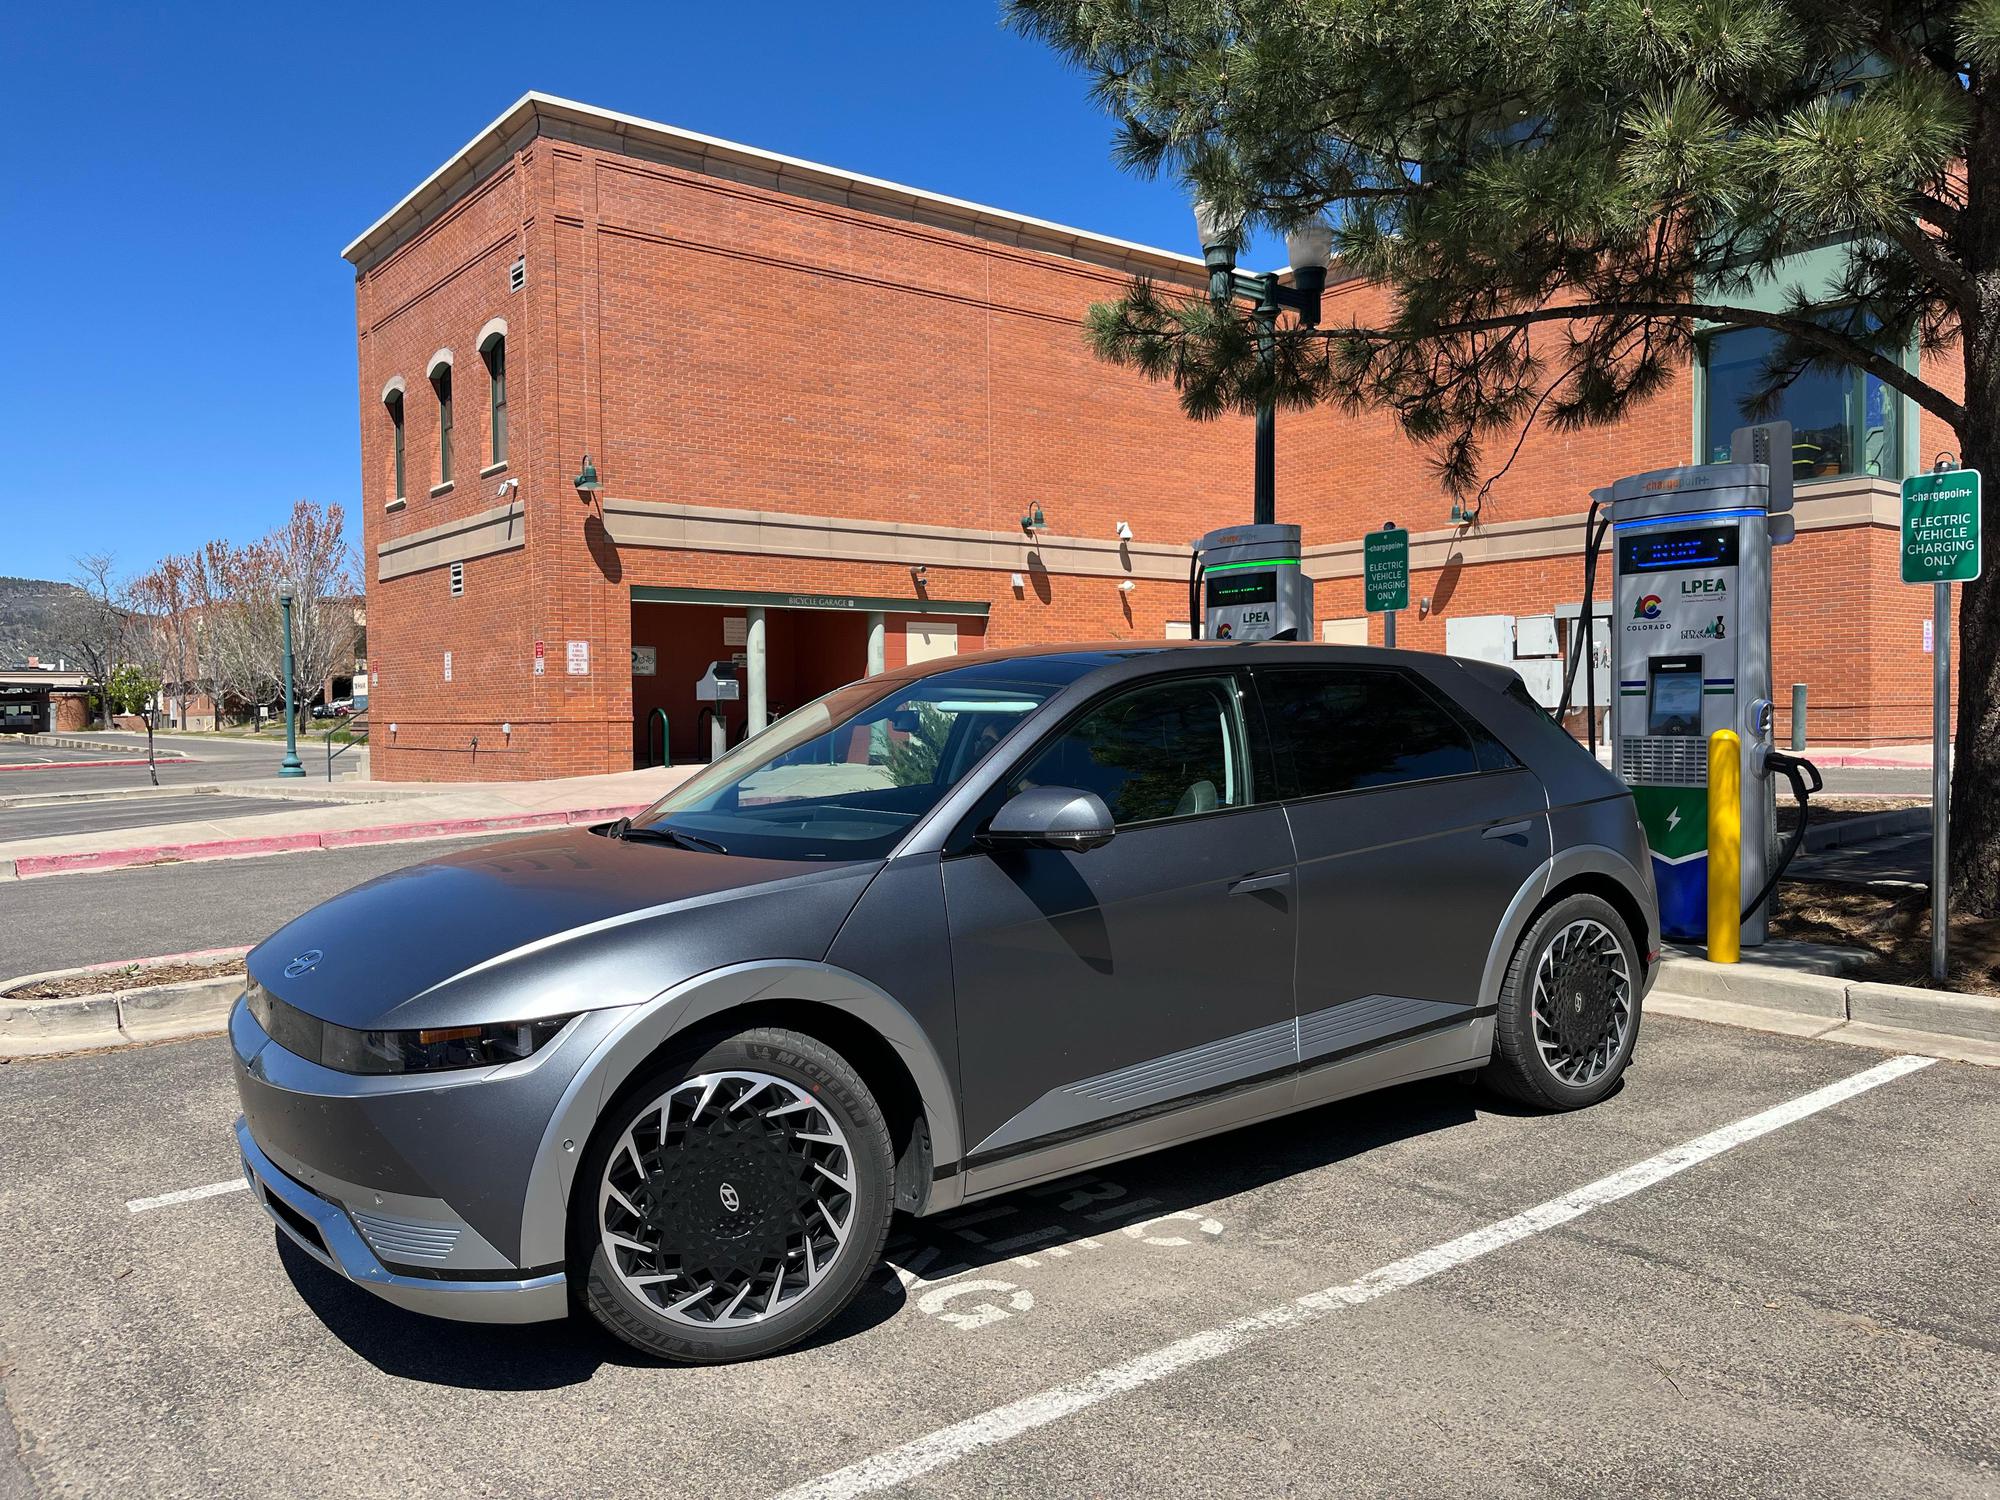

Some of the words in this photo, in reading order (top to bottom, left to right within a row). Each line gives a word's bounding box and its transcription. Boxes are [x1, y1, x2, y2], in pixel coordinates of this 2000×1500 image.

[1911, 513, 1971, 529] ELECTRIC
[1914, 527, 1968, 541] VEHICLE
[1907, 540, 1974, 555] CHARGING
[1369, 560, 1403, 572] ELECTRIC
[1924, 555, 1957, 566] ONLY
[1371, 571, 1402, 581] VEHICLE
[1368, 580, 1406, 591] CHARGING
[1681, 578, 1726, 594] LPEA
[1377, 591, 1396, 600] ONLY
[788, 597, 816, 605] BICYCLE
[818, 599, 846, 607] GARAGE
[1243, 611, 1270, 623] LPEA
[1626, 623, 1672, 631] COLORADO
[775, 1050, 867, 1120] MICHELIN
